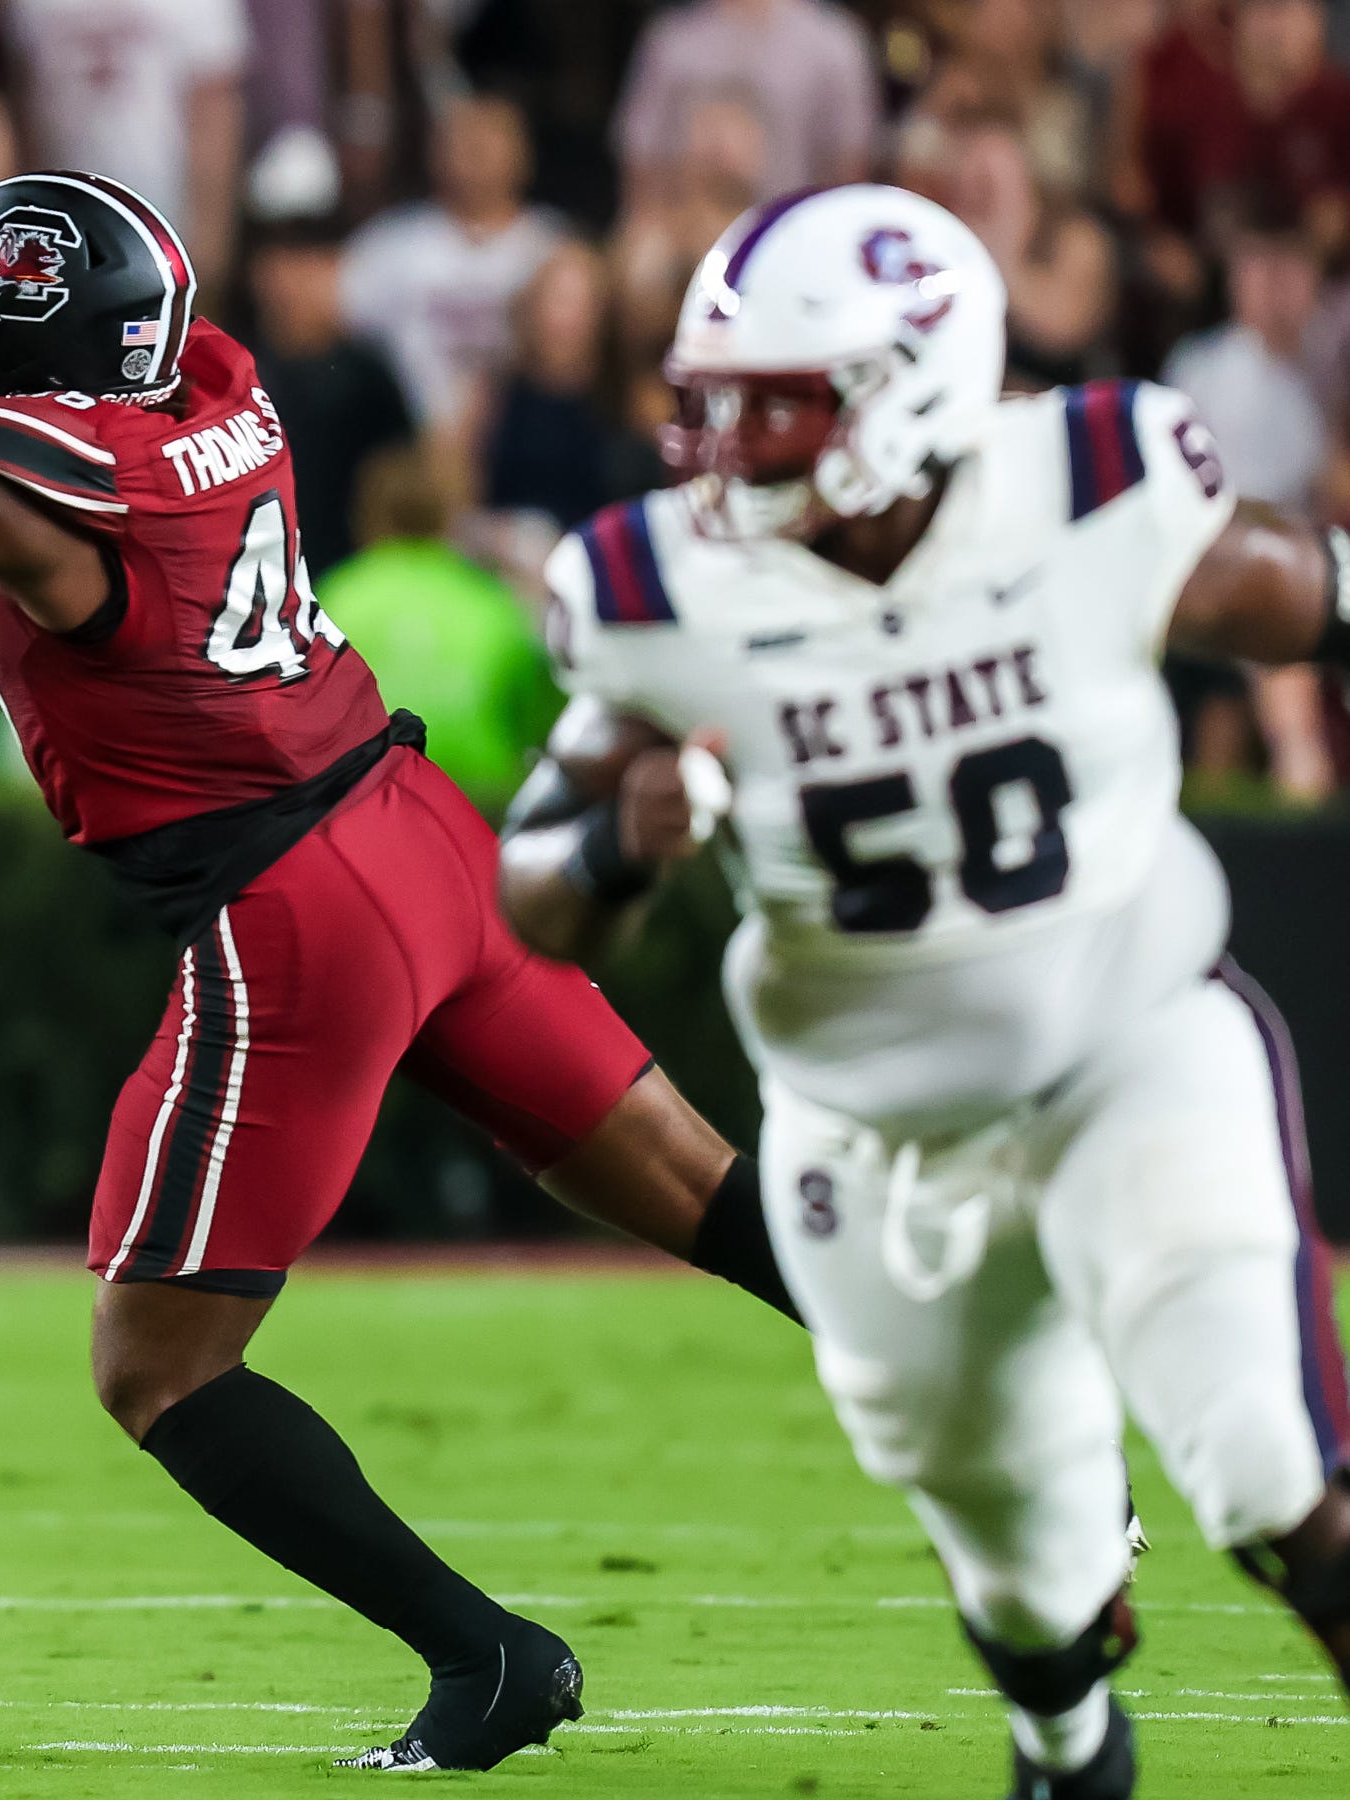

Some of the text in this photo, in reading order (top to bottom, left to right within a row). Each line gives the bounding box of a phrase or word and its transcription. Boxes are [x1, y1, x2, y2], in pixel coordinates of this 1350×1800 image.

[779, 645, 1047, 764] SC STATE
[798, 735, 1073, 935] 50
